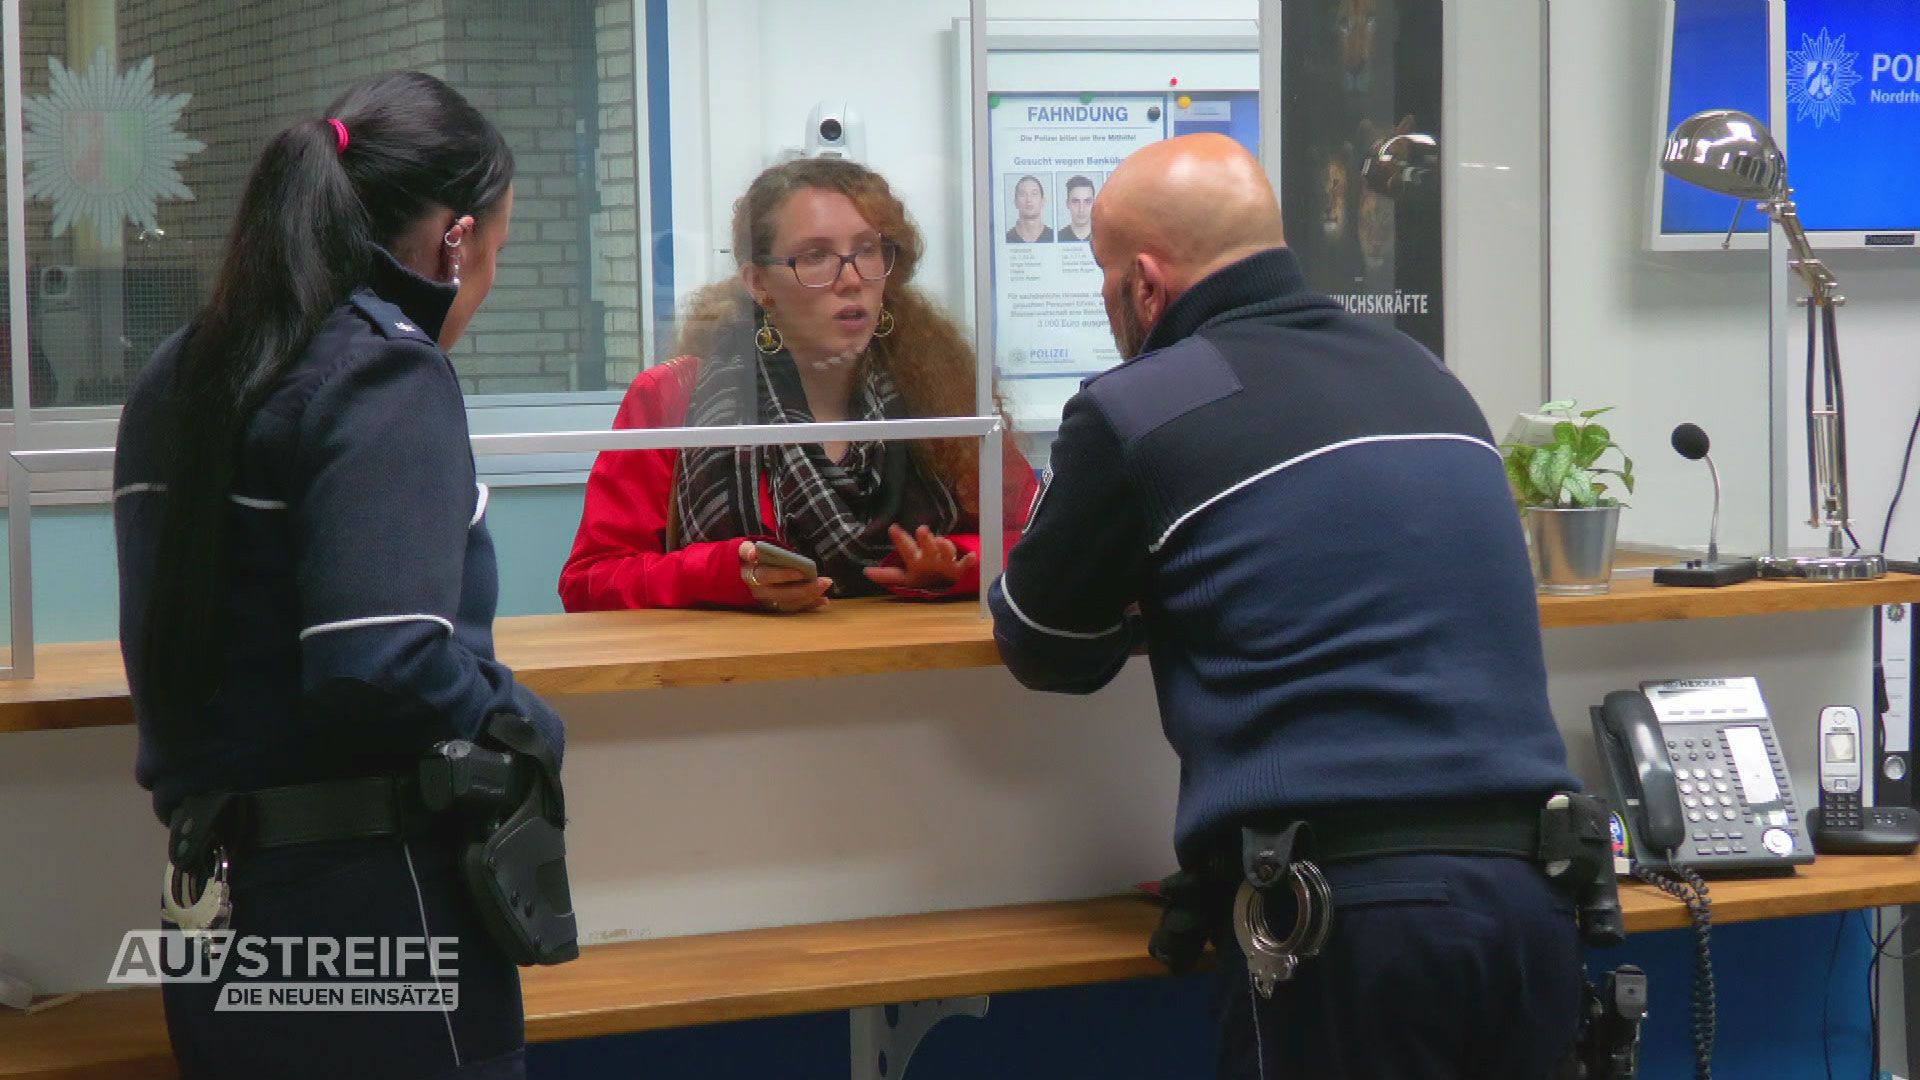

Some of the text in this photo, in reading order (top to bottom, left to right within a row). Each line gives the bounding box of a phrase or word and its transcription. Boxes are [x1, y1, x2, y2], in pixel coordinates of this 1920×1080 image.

[1871, 88, 1920, 104] Nordrh
[1027, 106, 1129, 122] FAHNDUNG
[1034, 134, 1058, 142] Polizei
[1013, 157, 1052, 166] Gesucht
[1054, 158, 1084, 168] wegen
[1061, 318, 1080, 328] Euro
[1030, 348, 1068, 358] POLIZEI
